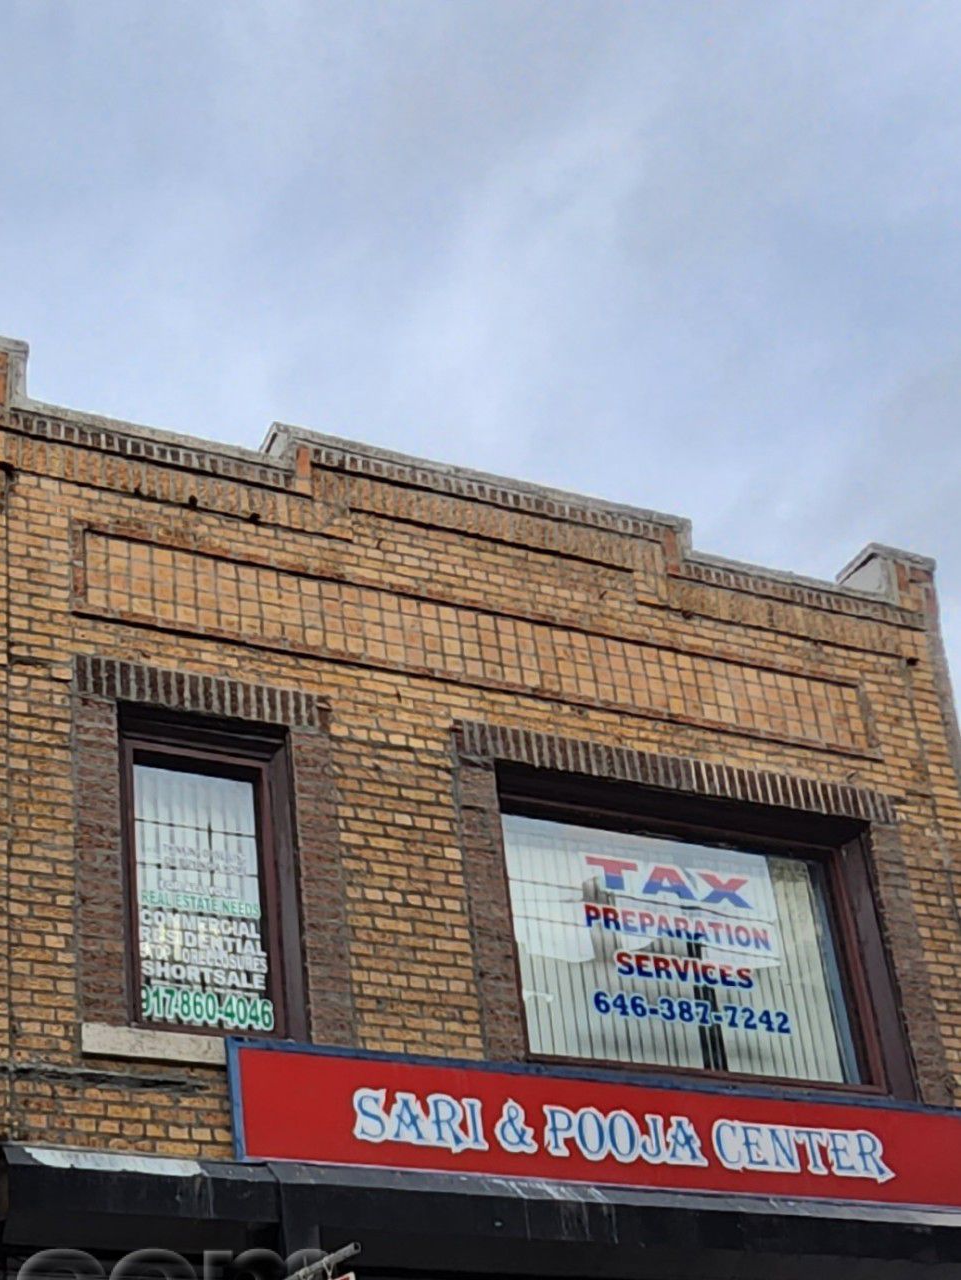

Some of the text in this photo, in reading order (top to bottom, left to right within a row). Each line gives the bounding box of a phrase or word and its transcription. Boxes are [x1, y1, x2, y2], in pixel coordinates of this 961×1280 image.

[141, 889, 260, 918] REAL ESTATE NEEDS
[585, 855, 753, 909] TAX
[139, 926, 267, 957] RESIDENTIAL
[140, 909, 261, 939] COMMERCIAL
[584, 903, 771, 951] PREPARATION
[615, 950, 755, 989] SERVICES
[141, 984, 274, 1032] 917-860-4046
[593, 990, 792, 1035] 646-387-7242
[354, 1088, 897, 1183] SARI & POOJA CENTER
